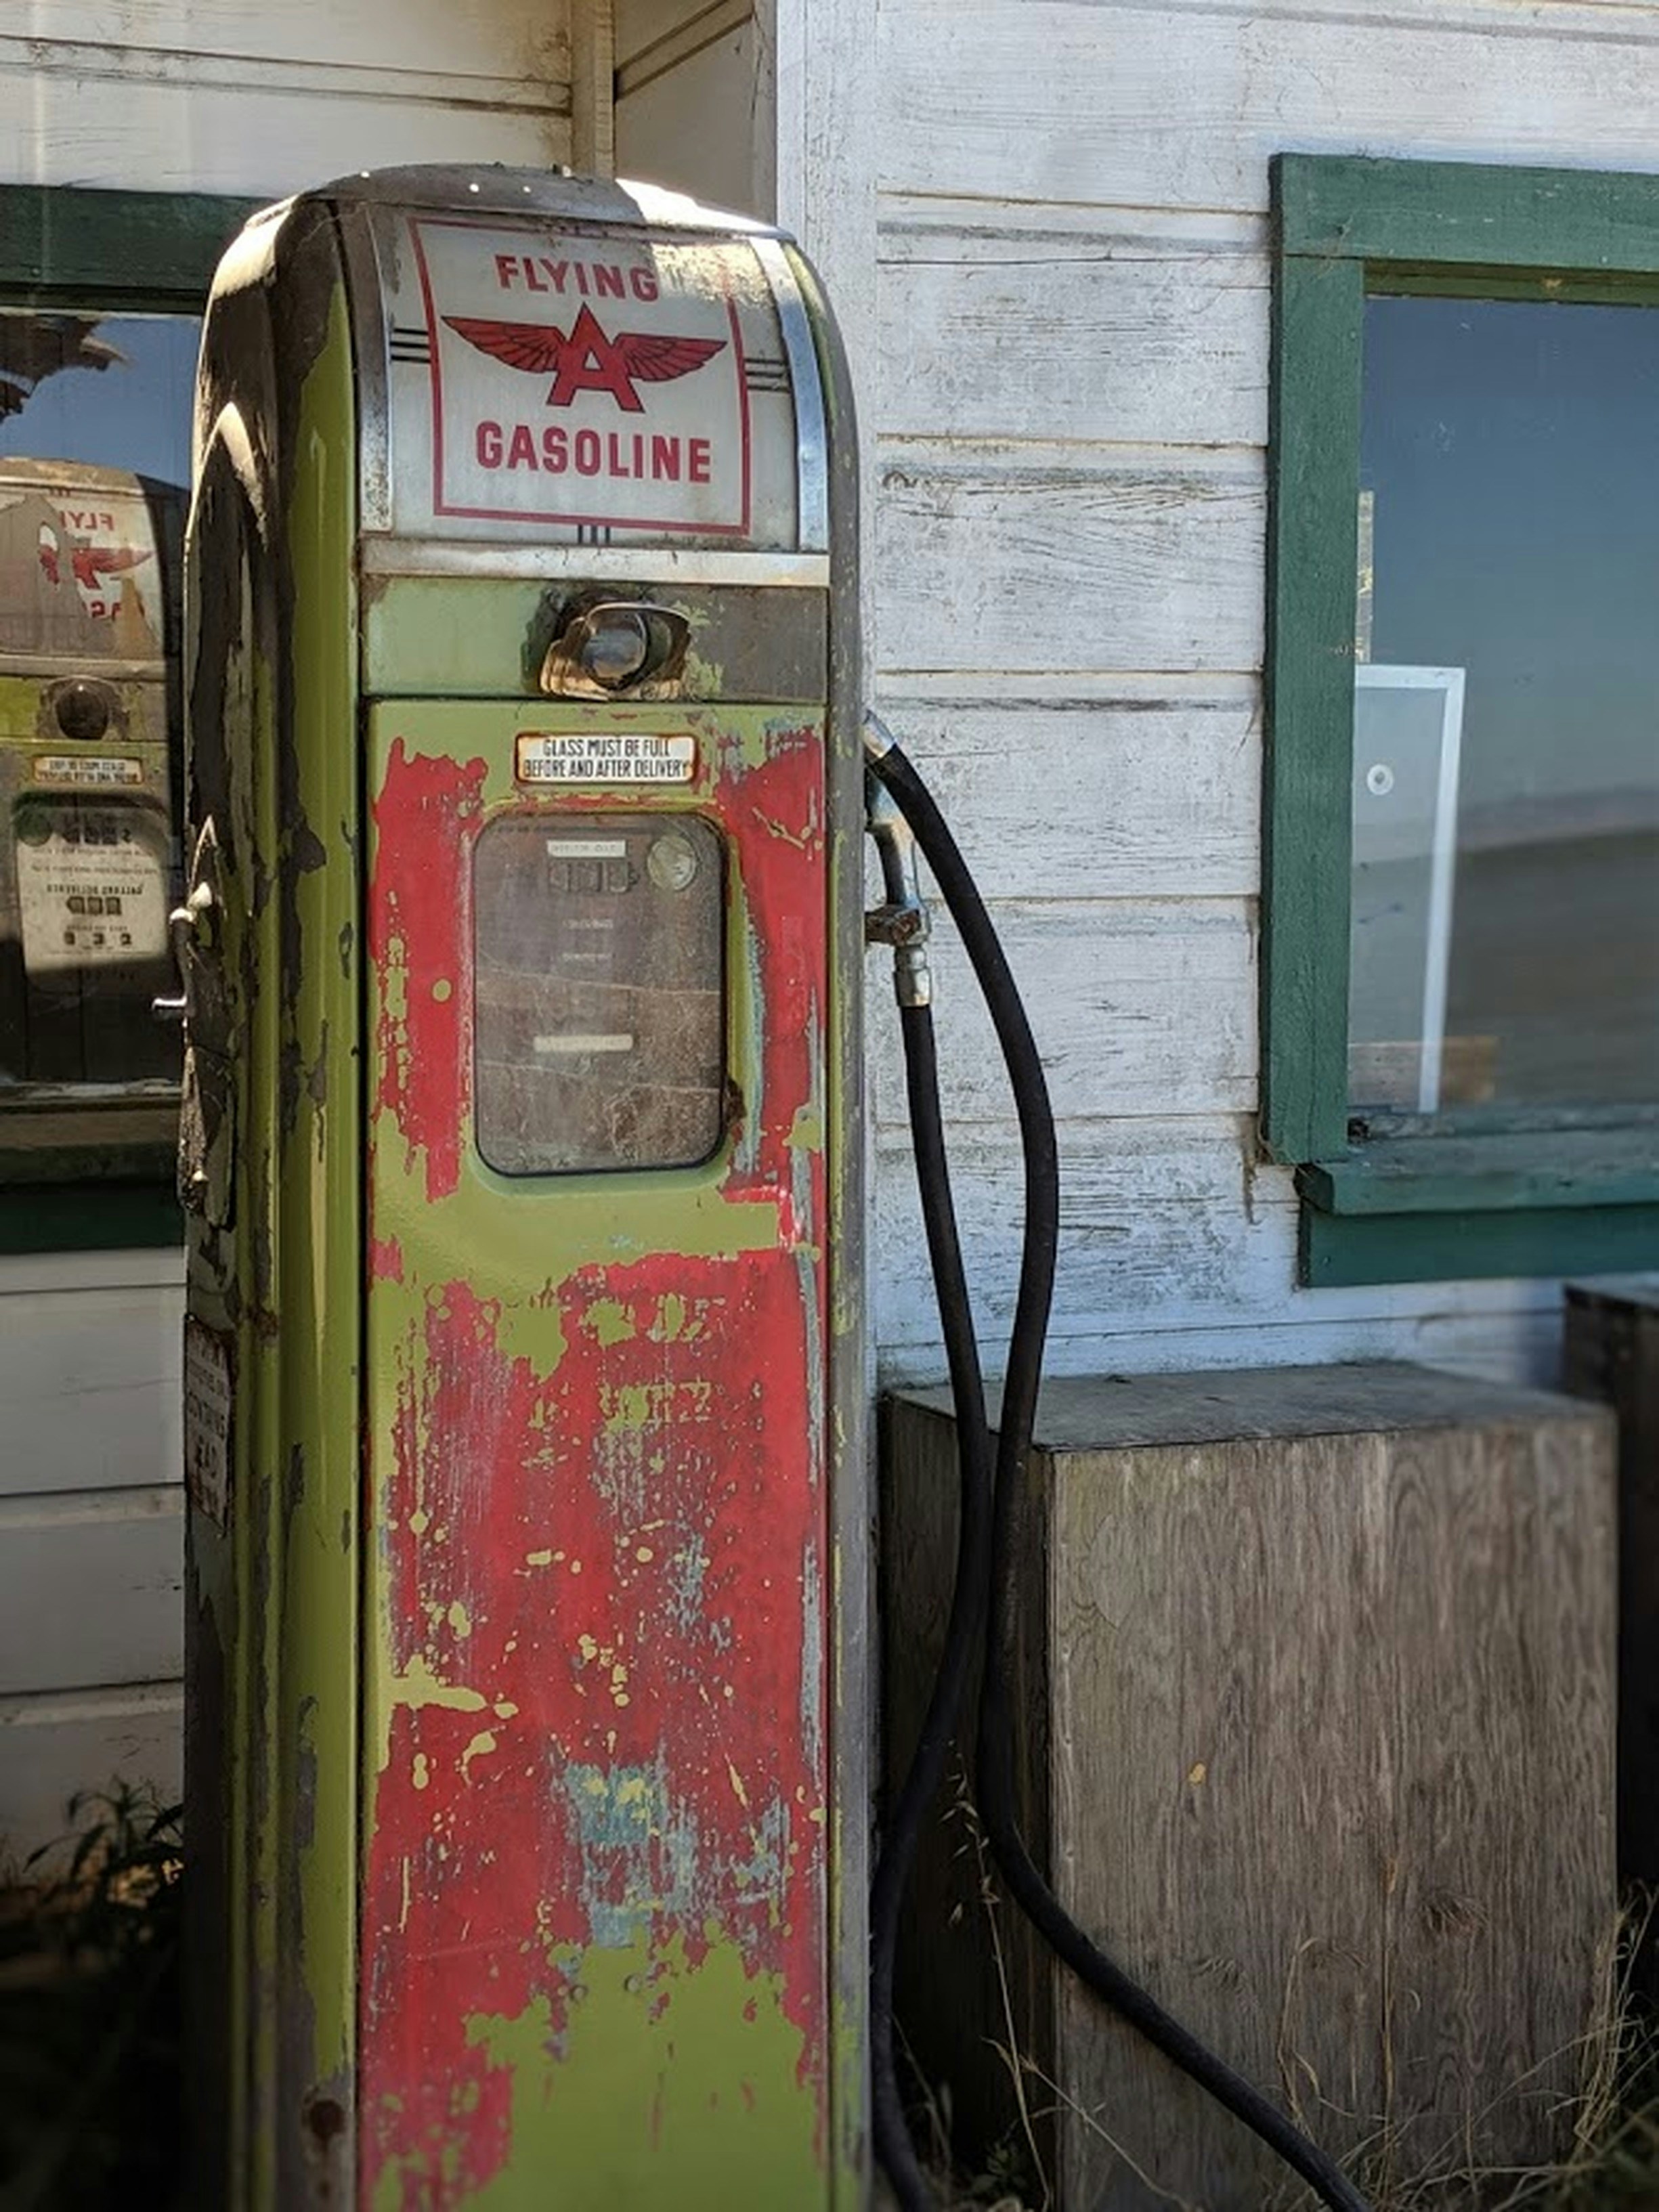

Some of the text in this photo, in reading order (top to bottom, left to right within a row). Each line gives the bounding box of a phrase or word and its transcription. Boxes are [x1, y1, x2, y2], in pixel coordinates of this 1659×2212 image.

[494, 255, 659, 301] FLYING
[546, 301, 645, 414] A
[476, 420, 710, 484] GASOLINE
[523, 759, 566, 778] BEFORE
[569, 759, 594, 778] AND
[597, 759, 631, 778] AFTER
[543, 739, 670, 757] GLASS MUST BE FULL
